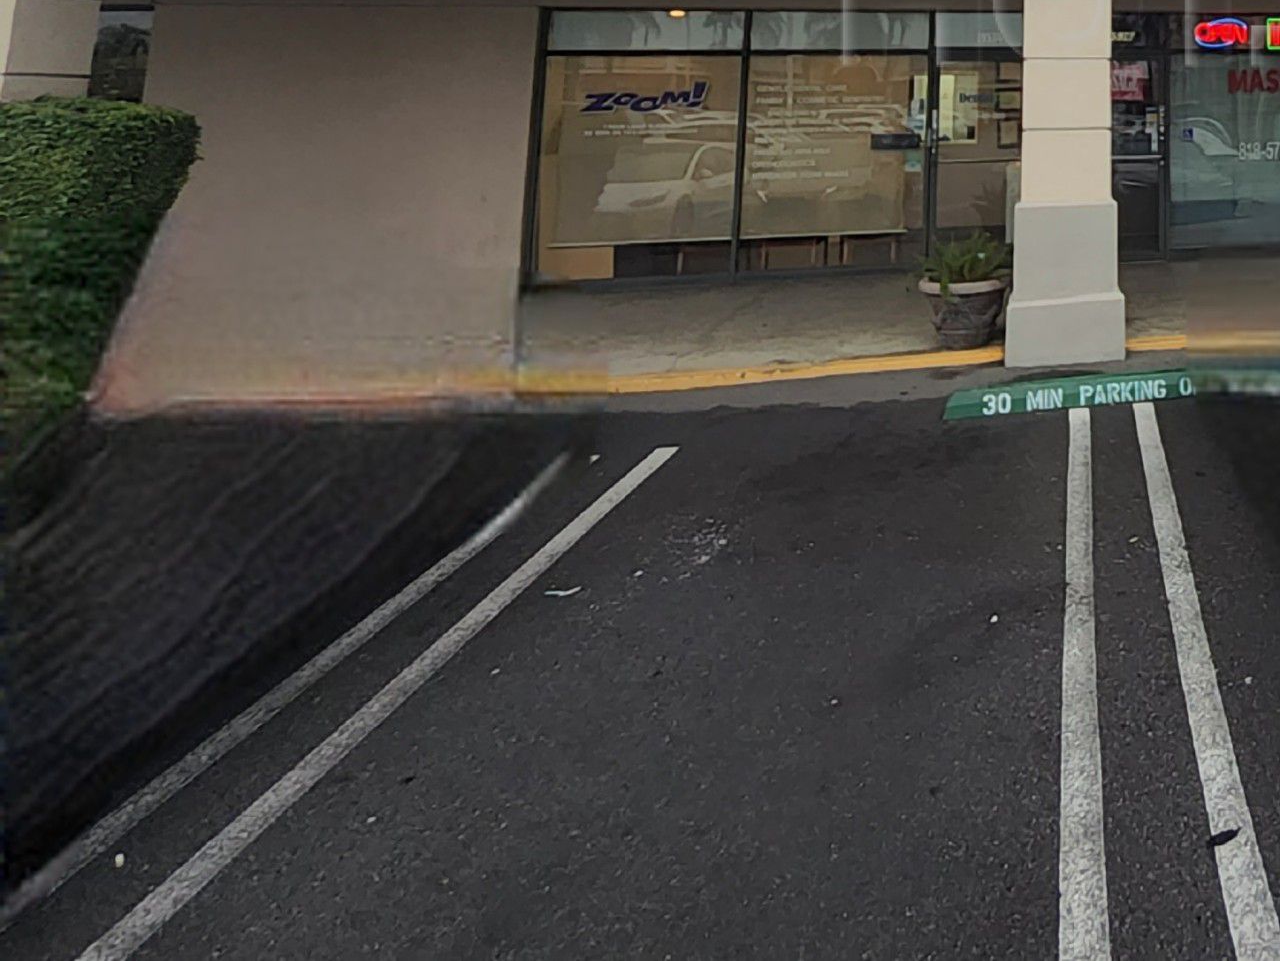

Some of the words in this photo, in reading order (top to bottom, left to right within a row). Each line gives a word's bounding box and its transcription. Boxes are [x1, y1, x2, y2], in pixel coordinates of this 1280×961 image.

[1194, 21, 1249, 45] OPEN
[981, 392, 1012, 416] 30
[1026, 388, 1064, 412] MIN
[1079, 379, 1167, 407] PARKING
